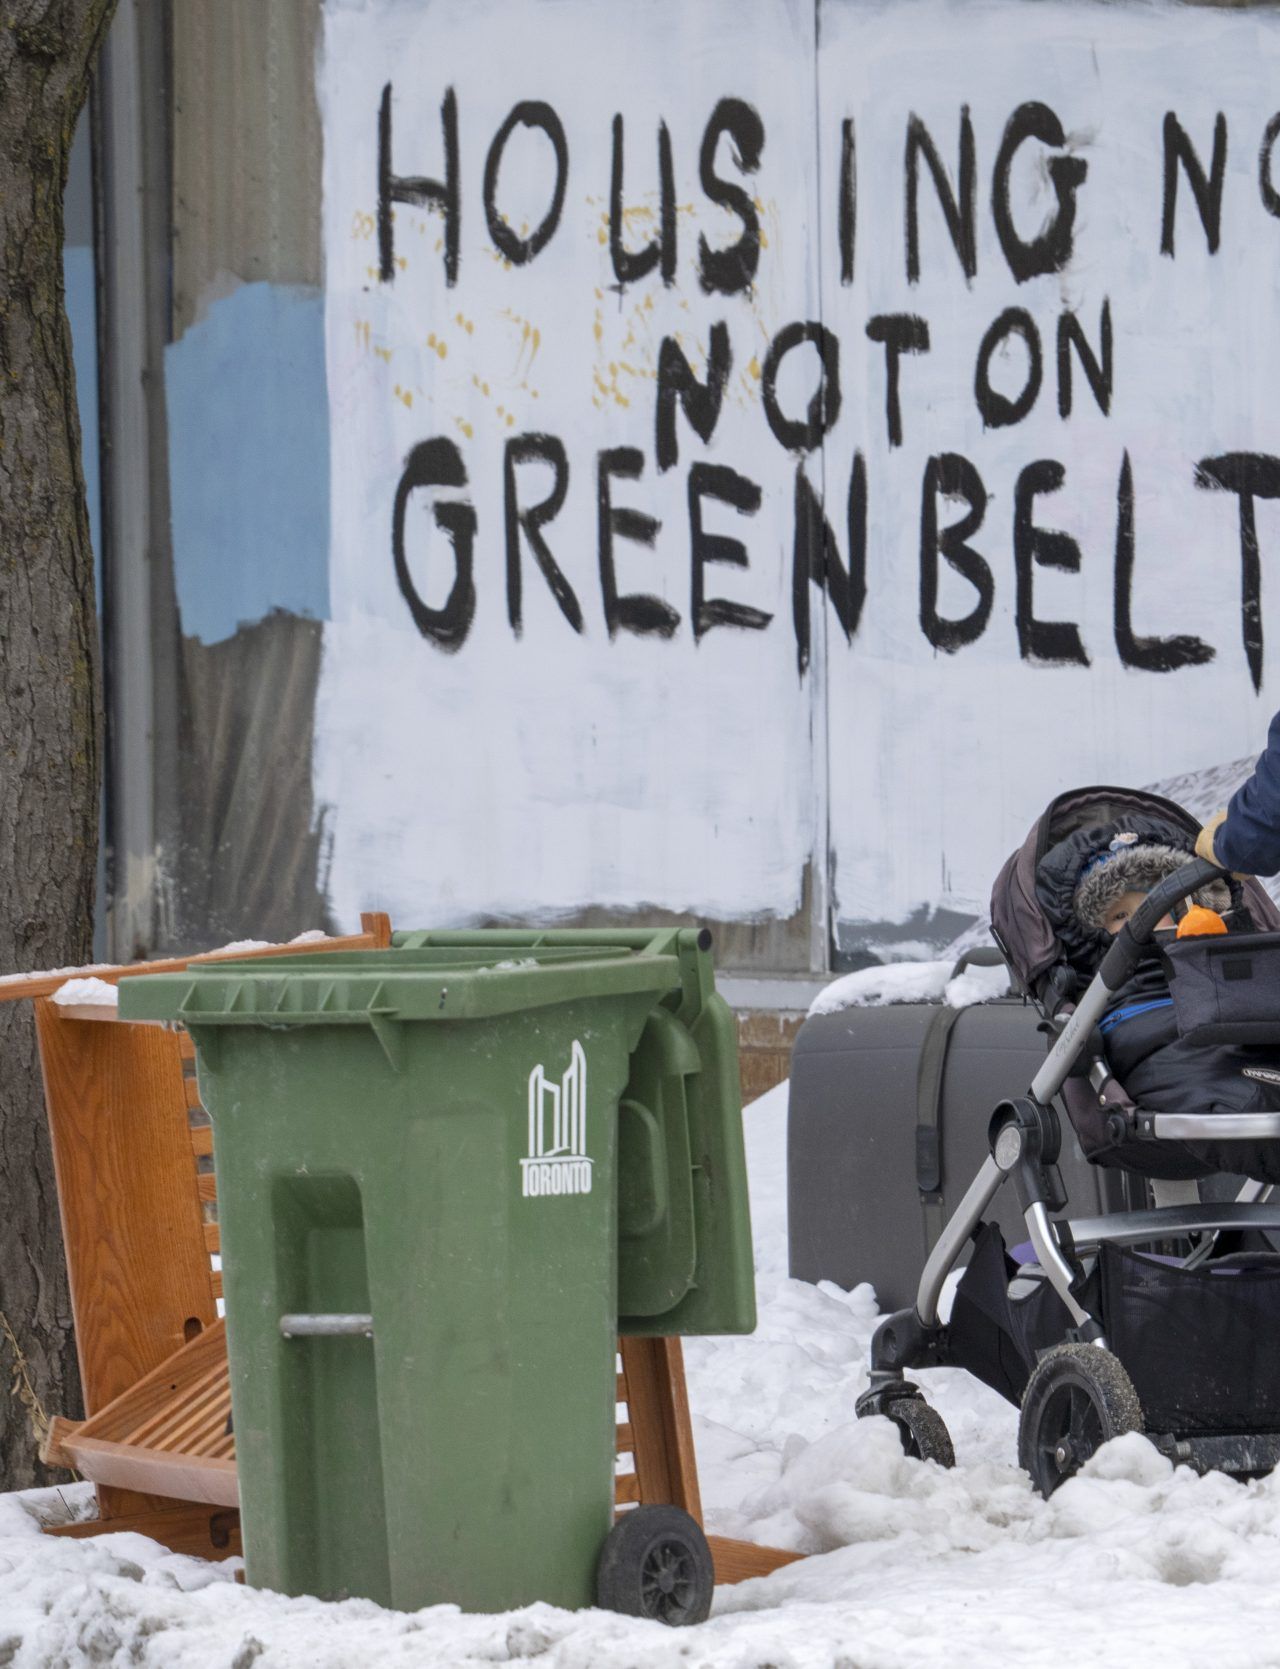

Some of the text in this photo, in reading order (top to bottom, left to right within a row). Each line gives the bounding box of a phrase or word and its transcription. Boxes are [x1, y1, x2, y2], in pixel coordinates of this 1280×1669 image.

[376, 81, 1089, 295] HOUSING
[655, 298, 1113, 472] NOT ON
[519, 1155, 595, 1197] TORONTO
